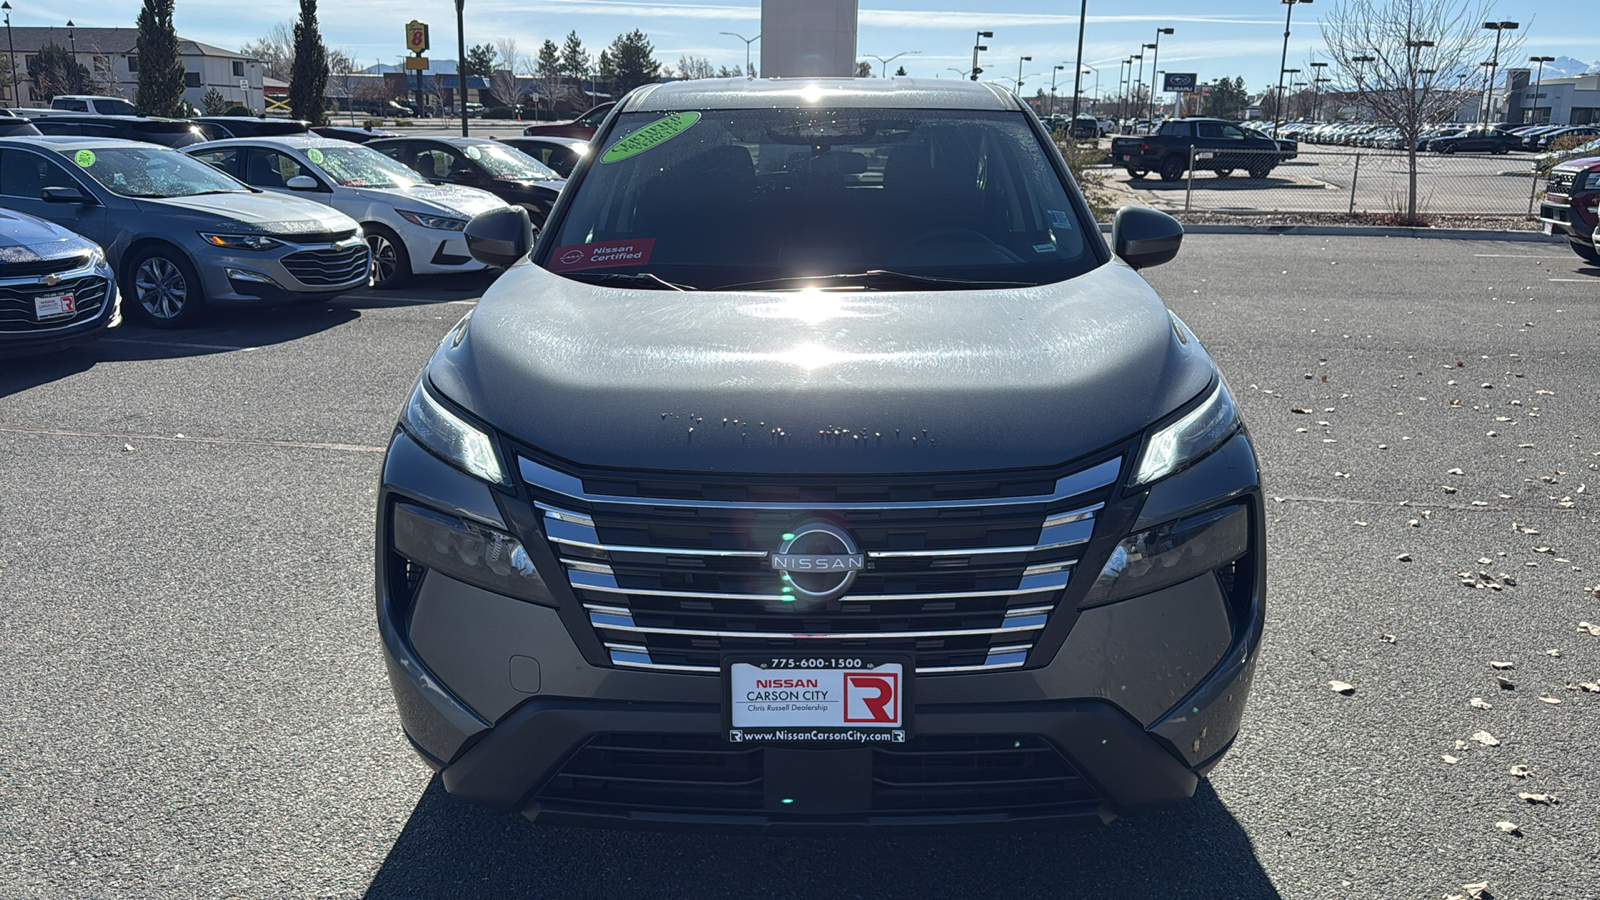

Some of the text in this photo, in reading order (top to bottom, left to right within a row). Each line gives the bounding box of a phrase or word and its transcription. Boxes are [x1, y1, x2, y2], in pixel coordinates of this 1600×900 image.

[412, 31, 422, 46] 8
[593, 246, 633, 255] Nissan
[590, 252, 642, 261] Certified
[774, 556, 862, 569] NISSAN
[771, 658, 862, 667] 775-600-1500
[756, 679, 818, 689] NISSAN
[746, 690, 828, 701] CARSON CITY
[747, 704, 765, 712] Chris
[791, 703, 828, 712] Dealership
[744, 730, 891, 743] www.NissanCarsonCity.com
